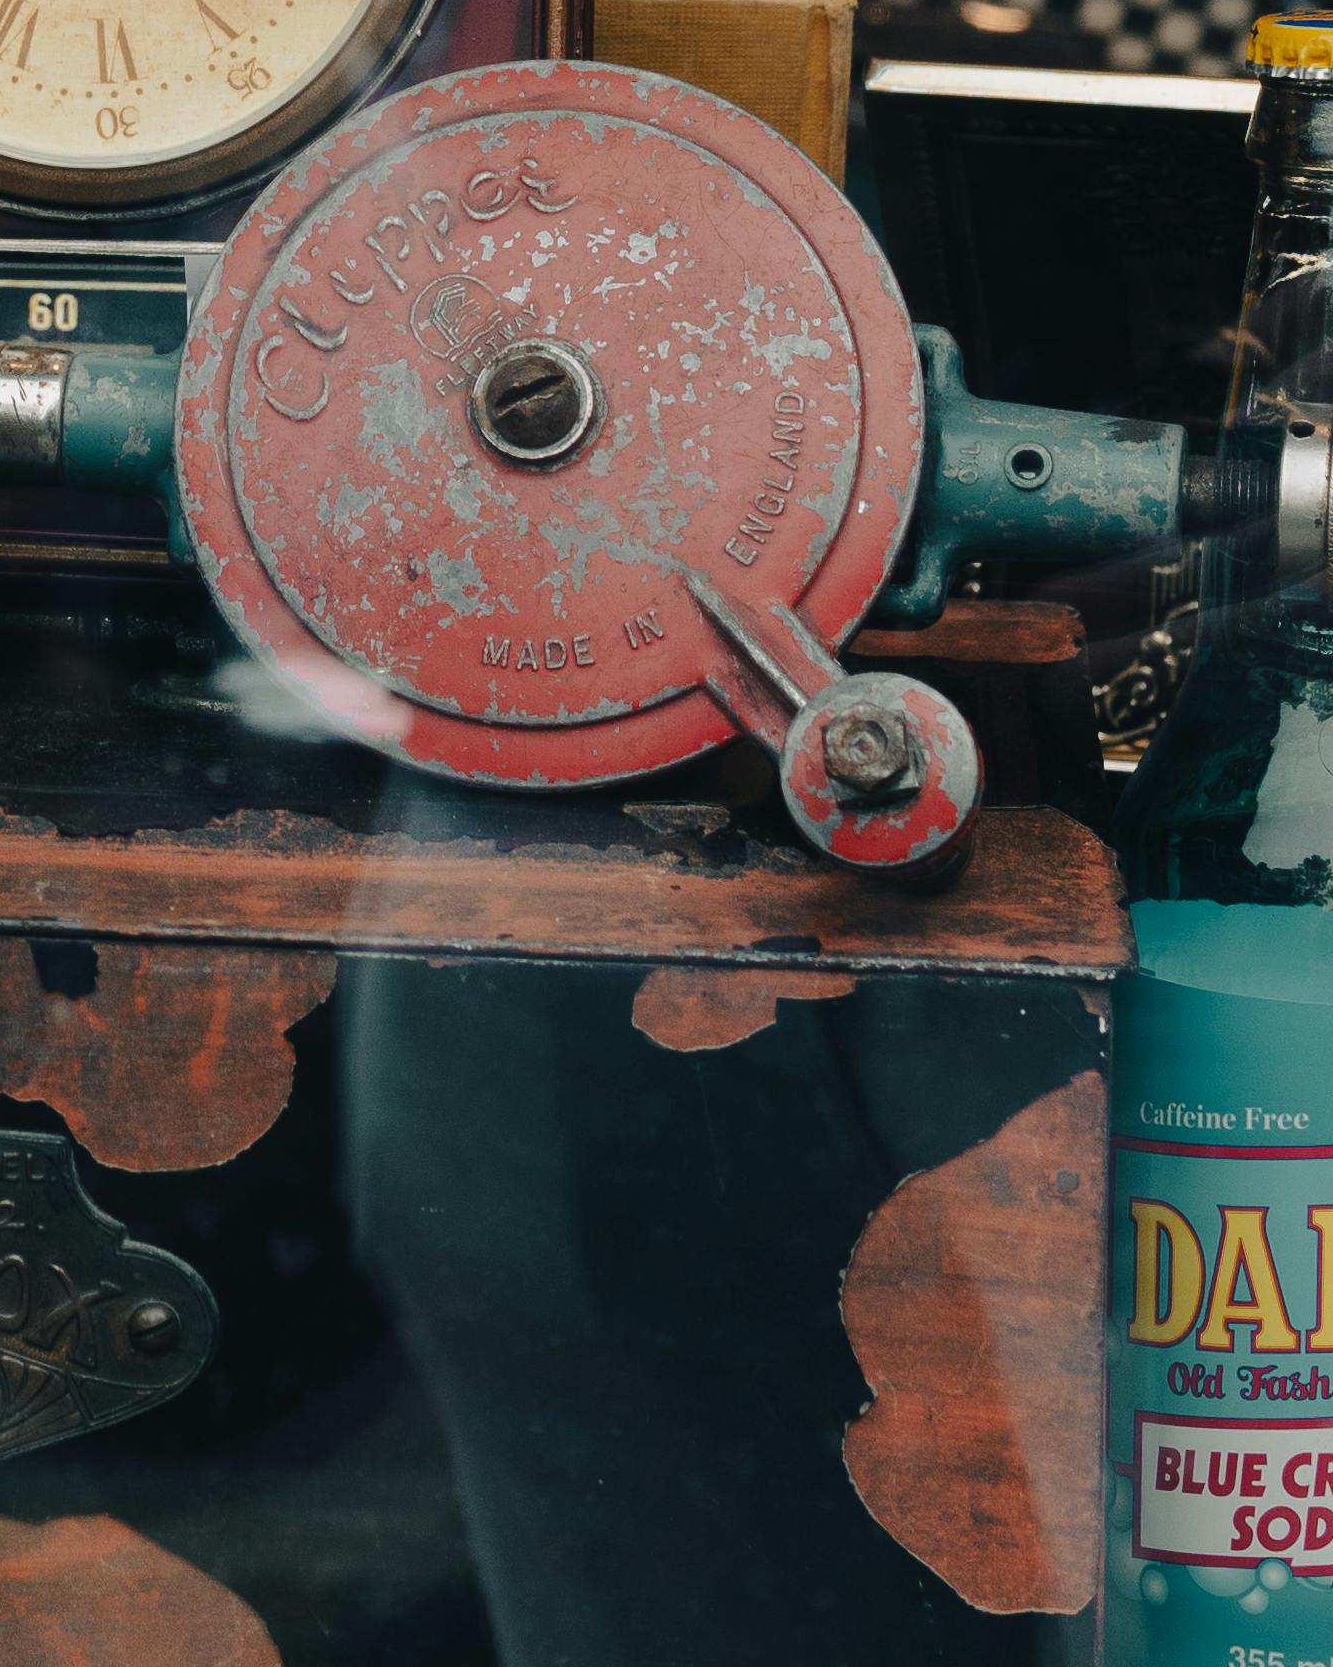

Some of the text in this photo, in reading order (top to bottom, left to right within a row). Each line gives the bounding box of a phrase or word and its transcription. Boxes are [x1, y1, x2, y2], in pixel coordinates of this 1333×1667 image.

[93, 15, 145, 84] VI
[227, 58, 271, 99] 25
[96, 107, 139, 141] 30
[29, 292, 78, 332] 60
[725, 390, 806, 567] ENGLAND
[482, 610, 664, 671] MADE IN
[1140, 1100, 1310, 1130] Caffeine Free
[1167, 1362, 1226, 1400] Old
[1156, 1446, 1268, 1498] BLUE
